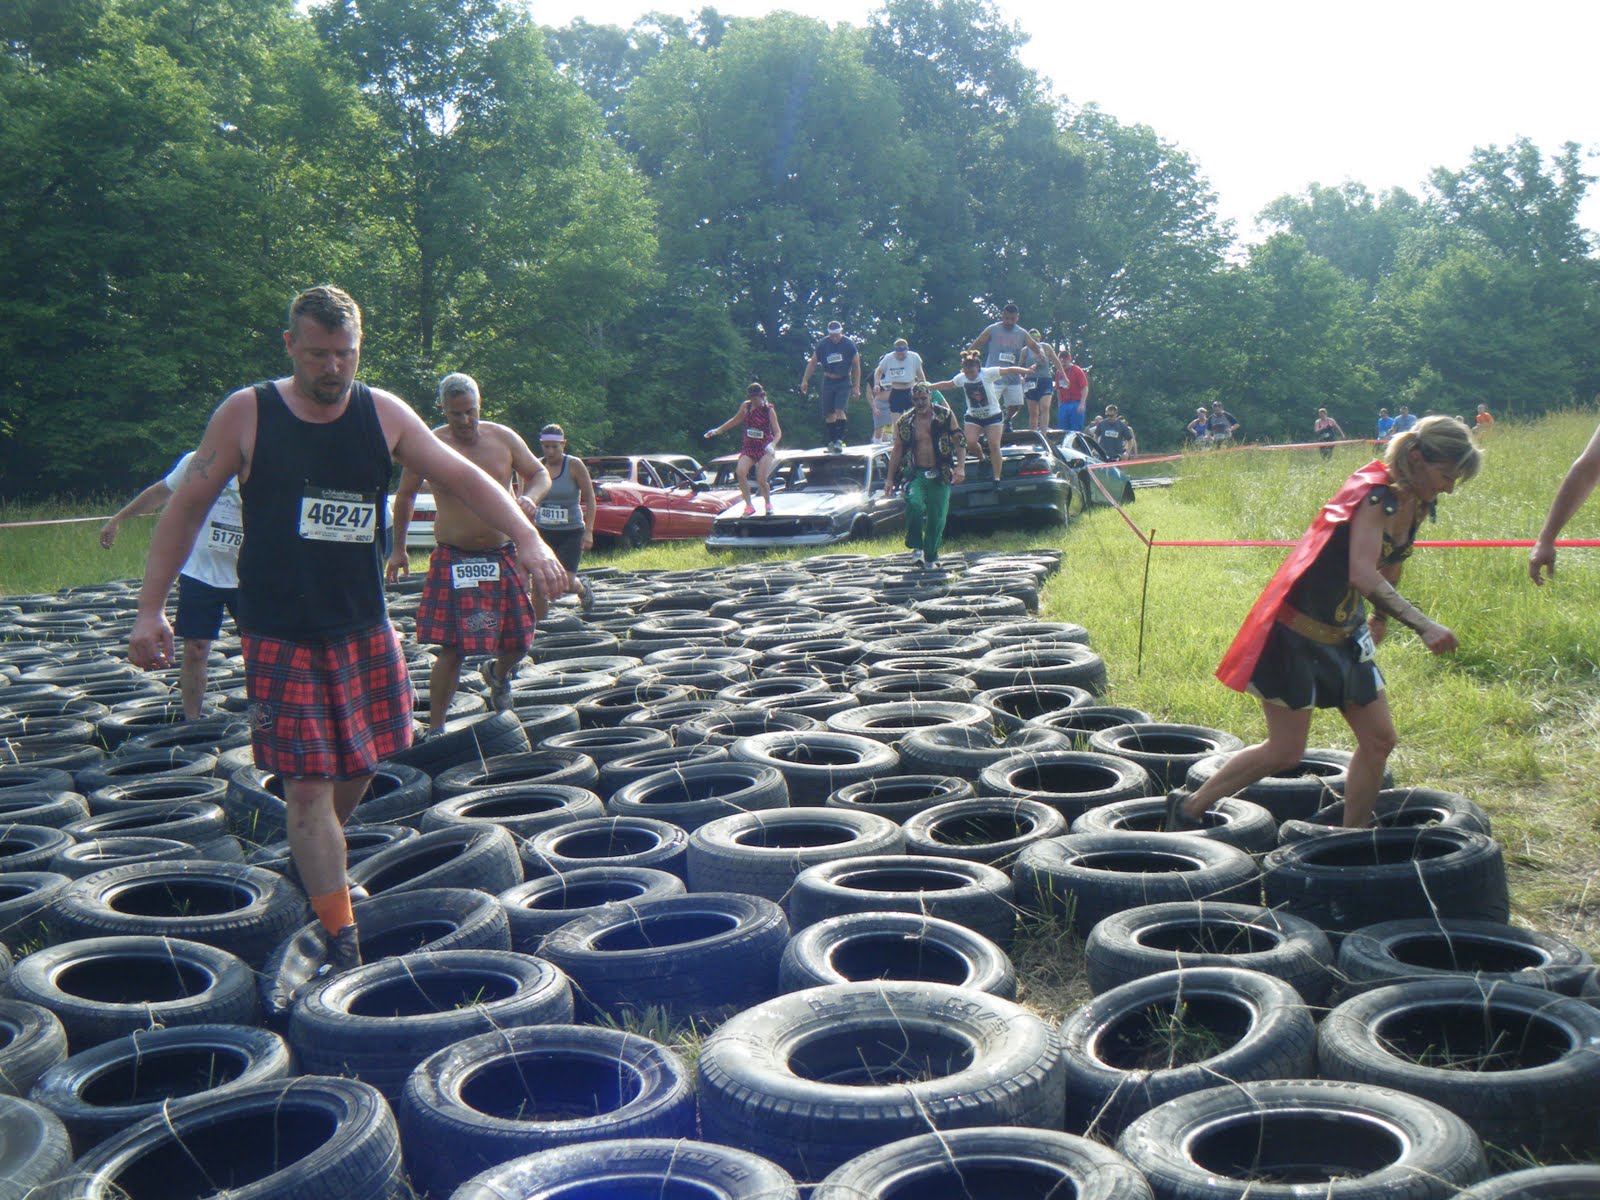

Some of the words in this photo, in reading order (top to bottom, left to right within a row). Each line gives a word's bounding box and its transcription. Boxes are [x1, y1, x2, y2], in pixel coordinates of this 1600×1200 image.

[307, 502, 374, 528] 46247
[541, 508, 565, 519] 48111
[456, 564, 497, 579] 59962
[808, 990, 917, 1015] LTX
